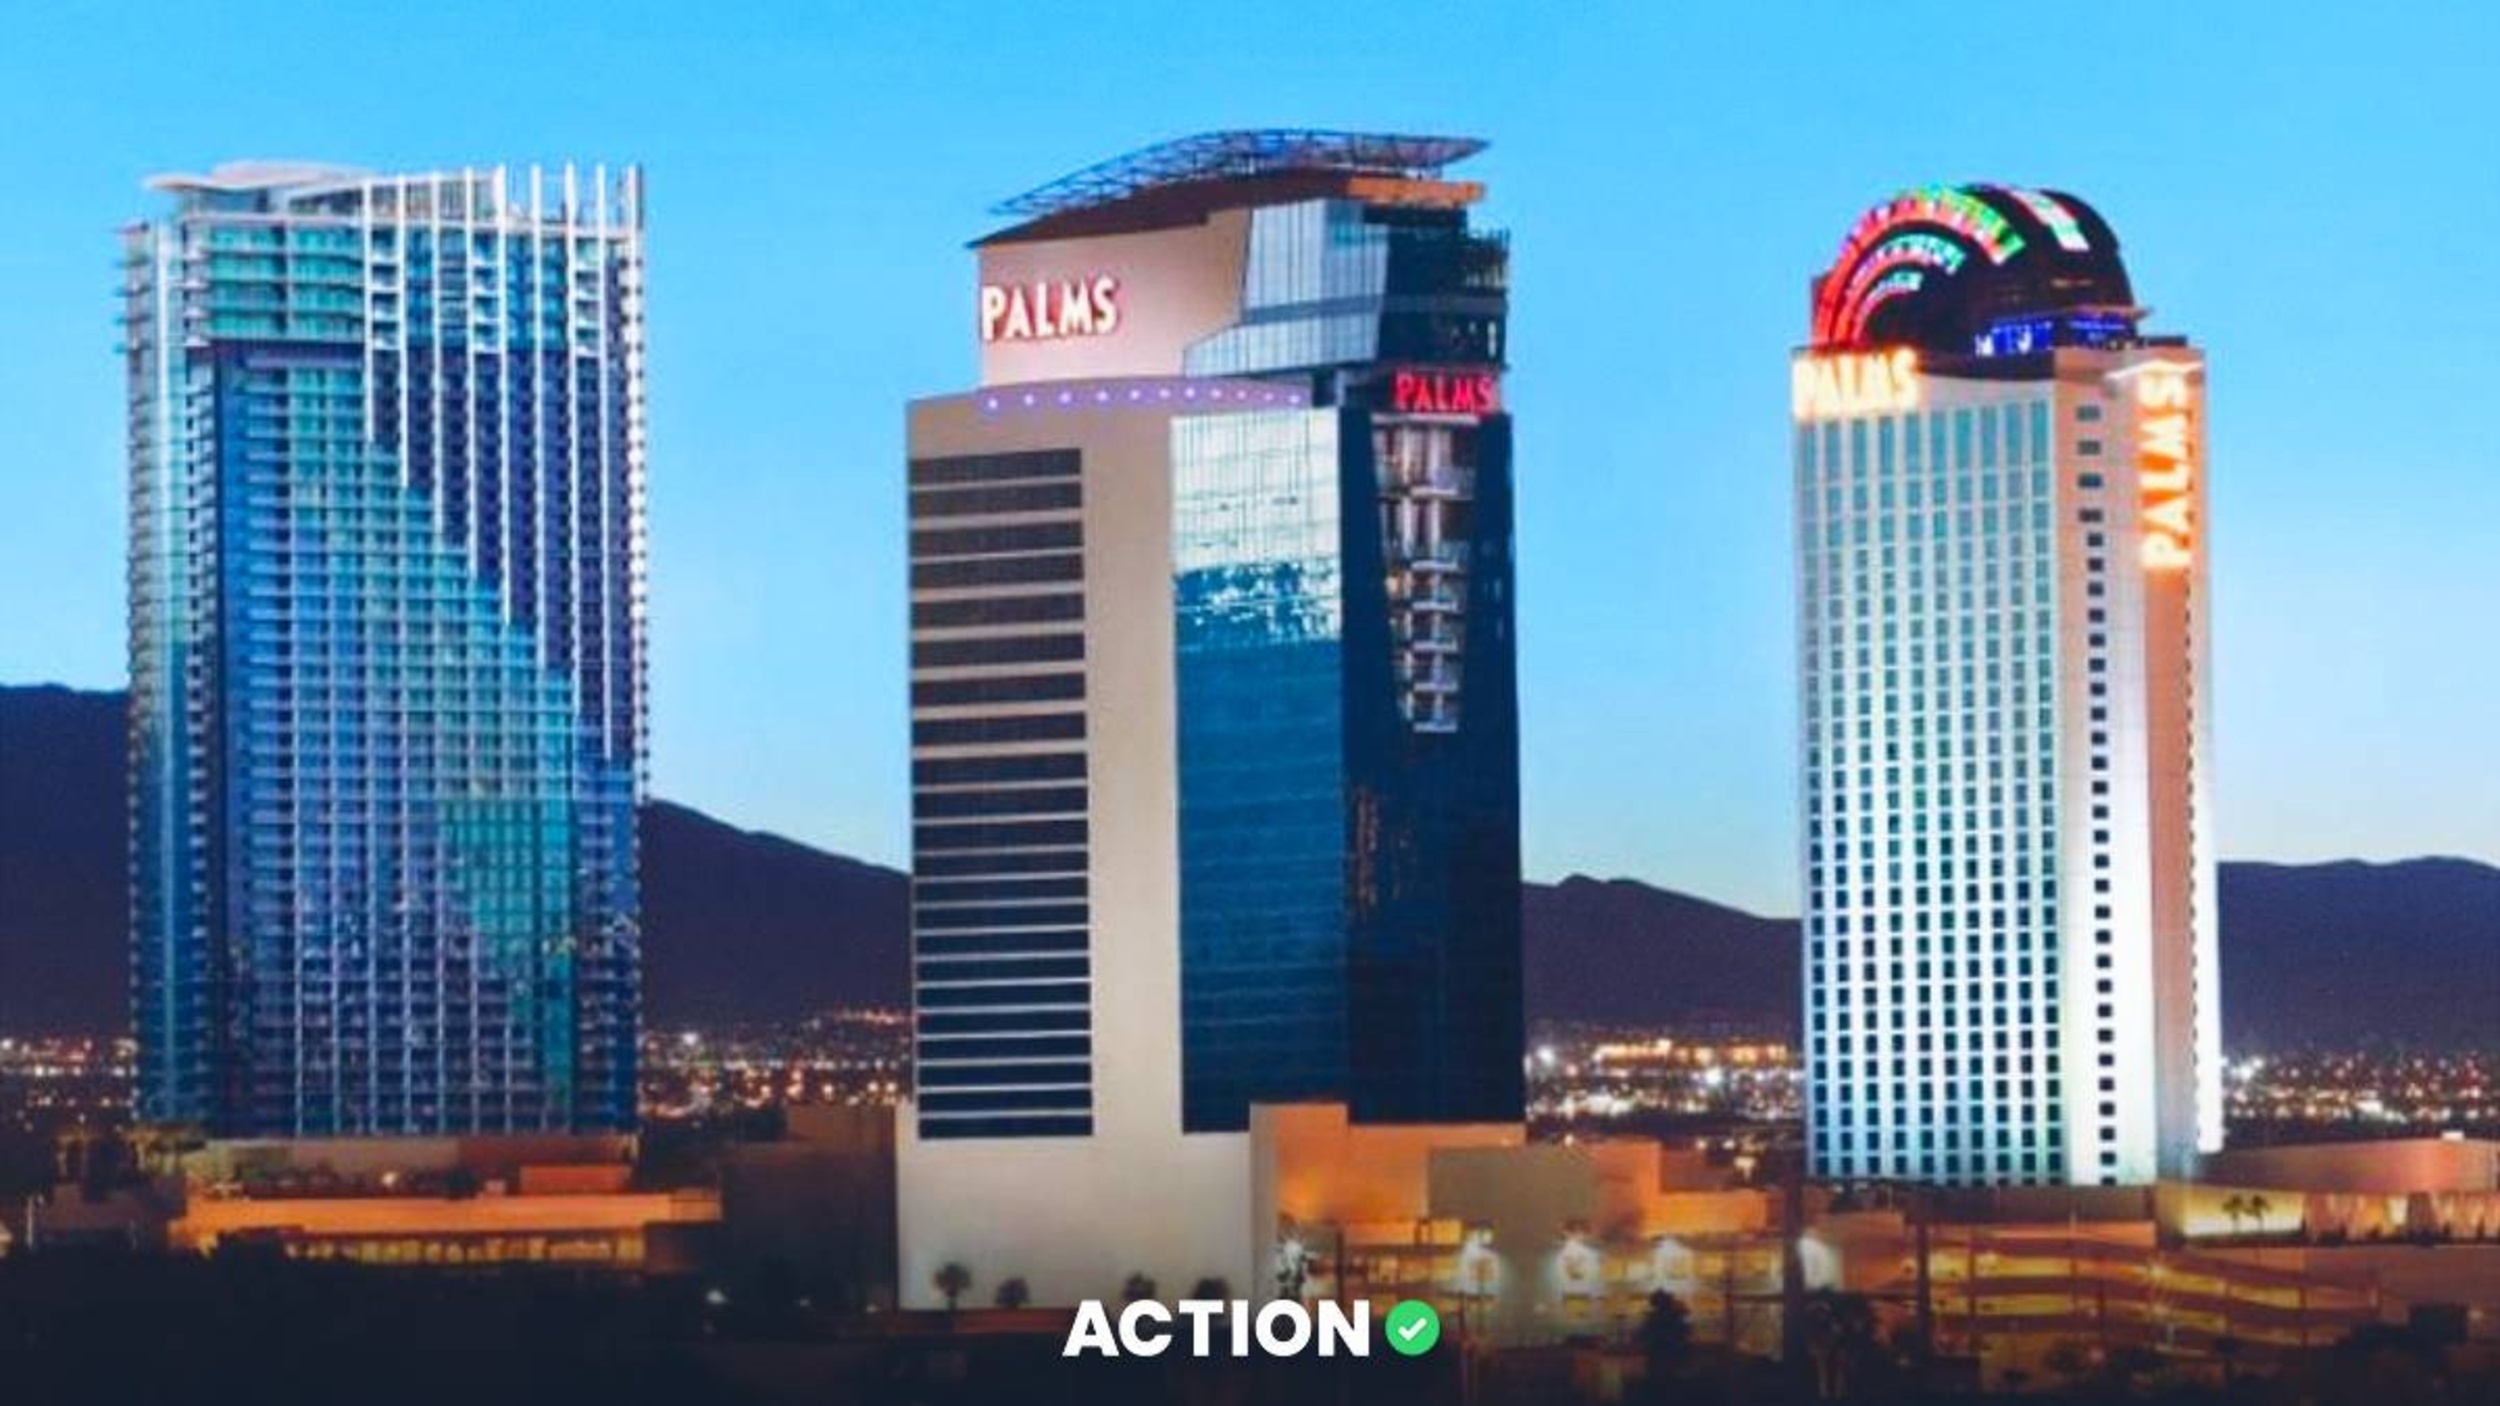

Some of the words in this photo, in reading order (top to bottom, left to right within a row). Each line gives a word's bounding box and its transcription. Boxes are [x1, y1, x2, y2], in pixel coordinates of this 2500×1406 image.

[981, 275, 1118, 341] PALMS
[1395, 370, 1495, 412] PALMS
[2139, 370, 2192, 569] PALMS
